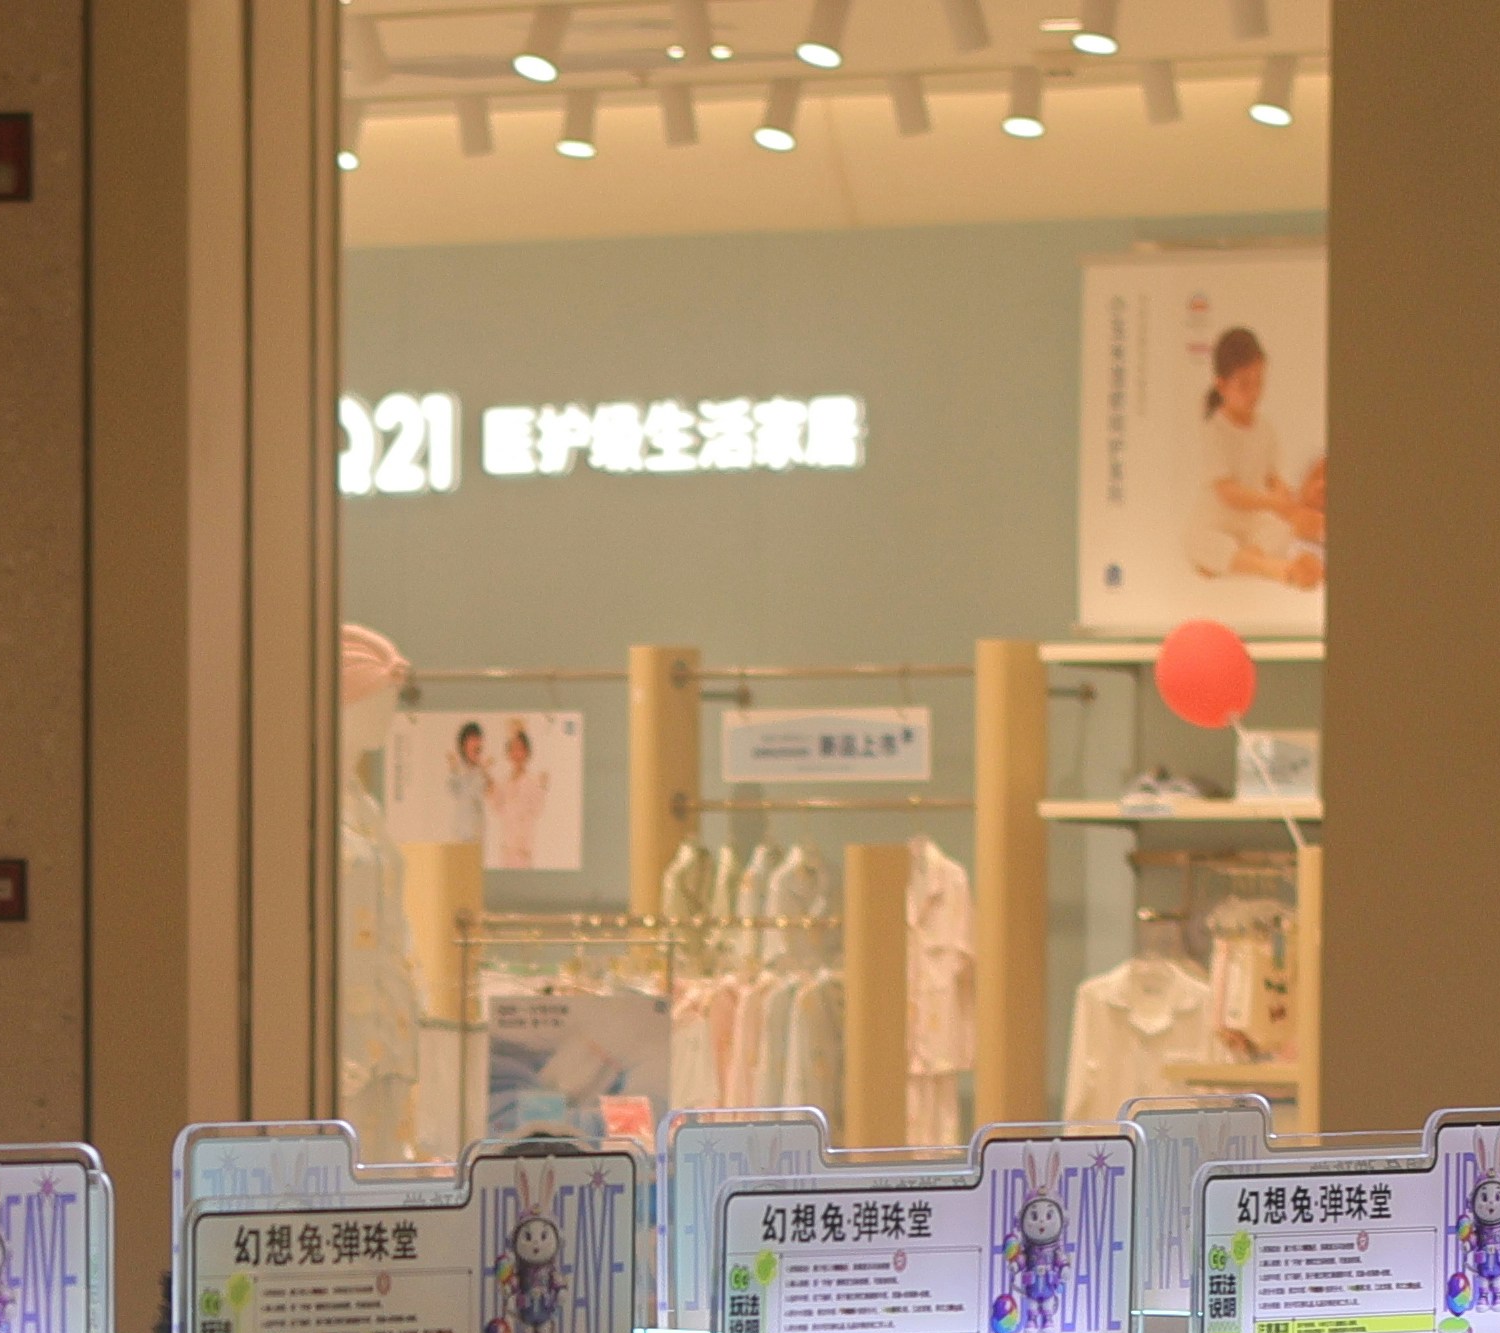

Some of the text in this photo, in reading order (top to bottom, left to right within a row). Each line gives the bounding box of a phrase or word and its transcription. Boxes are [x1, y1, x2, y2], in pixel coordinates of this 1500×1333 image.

[761, 1199, 934, 1244] 幻想兔·弹珠堂
[1237, 1183, 1393, 1227] 幻想兔·弹珠堂
[234, 1219, 419, 1267] 幻想兔·弹珠堂
[1208, 1273, 1238, 1296] 玩法
[1209, 1296, 1238, 1319] 说明
